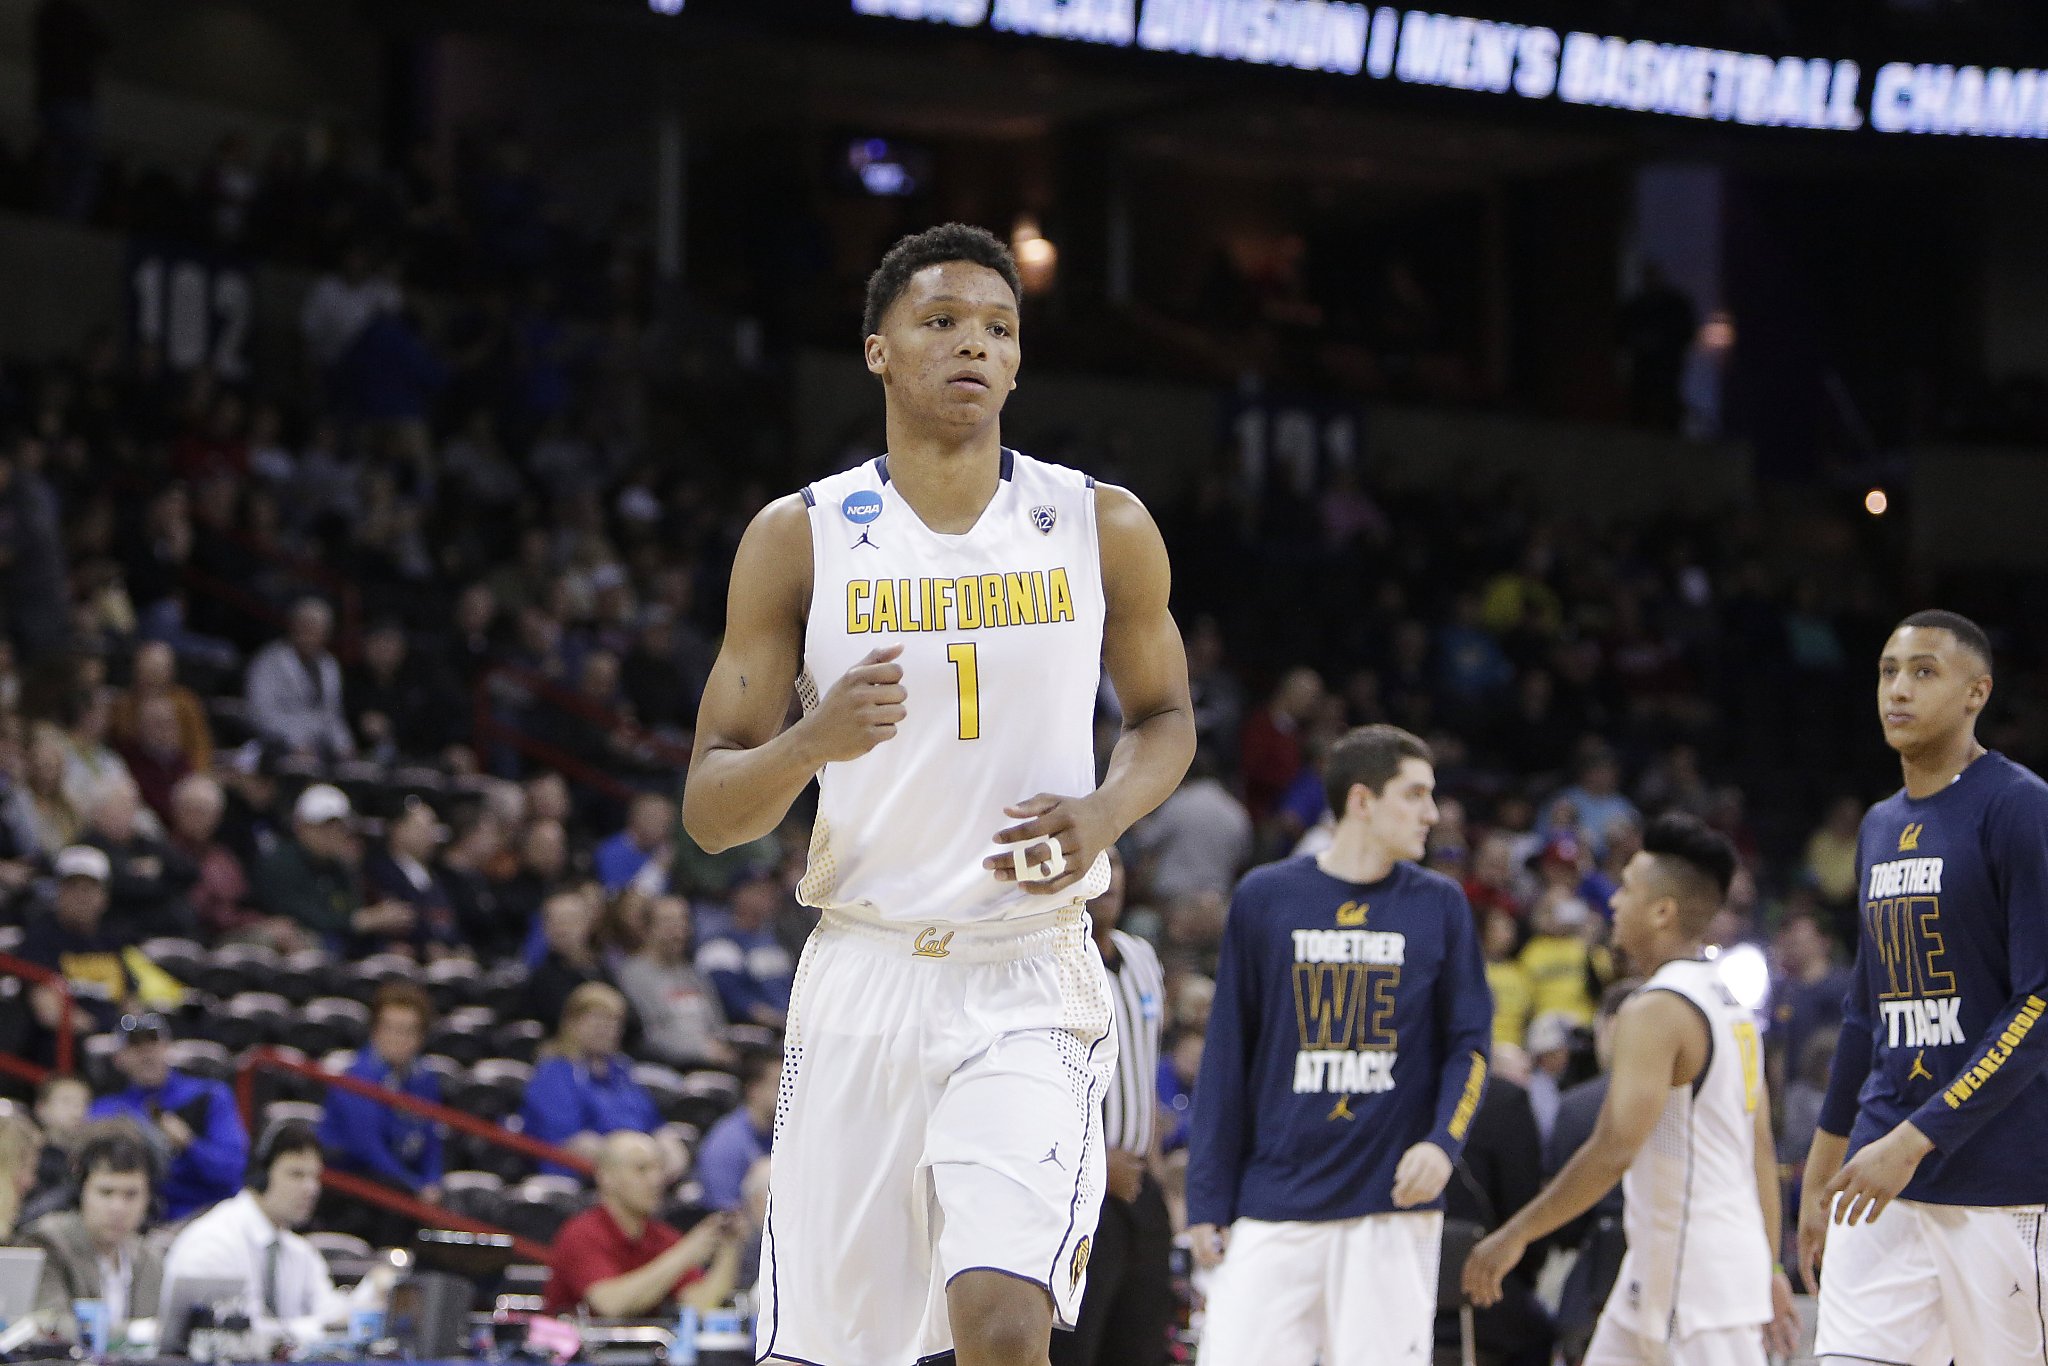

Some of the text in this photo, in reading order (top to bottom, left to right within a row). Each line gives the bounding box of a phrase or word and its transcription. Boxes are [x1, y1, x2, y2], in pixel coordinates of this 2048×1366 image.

[1136, 0, 1369, 76] DIVISION
[1396, 10, 1561, 99] MEN'S
[1557, 30, 1864, 131] BASKETBALL
[1869, 61, 2048, 140] CHAM
[132, 256, 254, 382] 102
[846, 503, 880, 515] NCAA
[1031, 505, 1056, 524] PAC
[1038, 516, 1052, 530] 12
[847, 567, 1075, 634] CALIFORNIA
[946, 642, 980, 740] 1
[1868, 857, 1944, 899] TOGETHER
[911, 926, 955, 958] Cal
[1291, 929, 1406, 965] TOGETHER
[1866, 896, 1957, 999] WE
[1292, 962, 1401, 1050] WE
[1880, 996, 1967, 1049] TTACK
[1292, 1050, 1398, 1094] ATTACK
[1943, 994, 2047, 1110] #WEAREJORDAN
